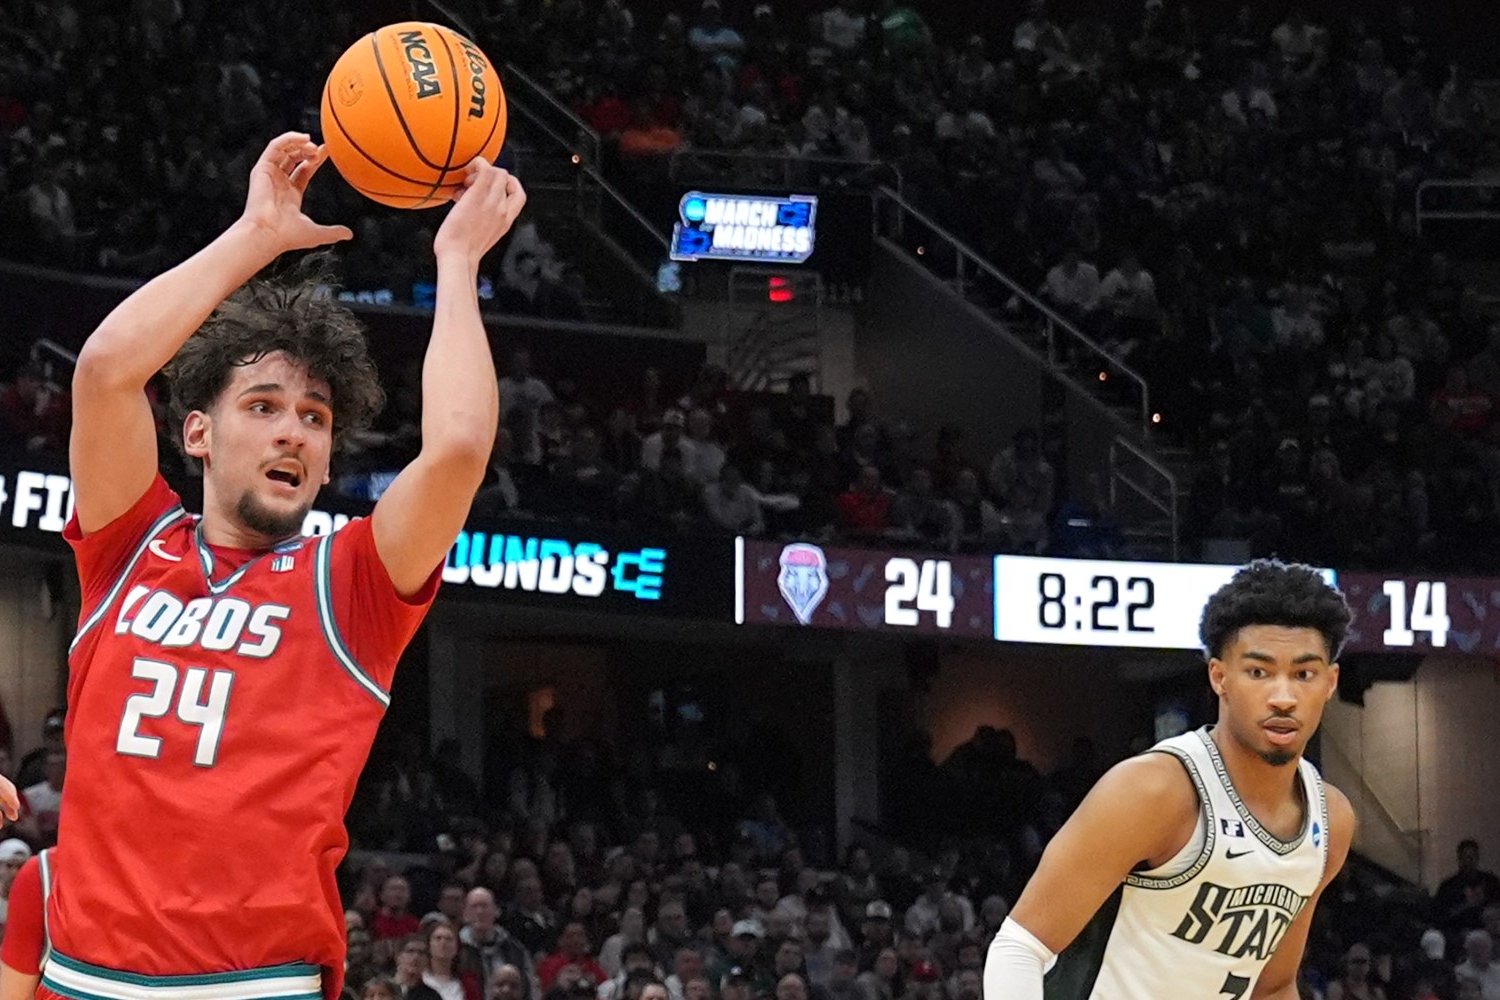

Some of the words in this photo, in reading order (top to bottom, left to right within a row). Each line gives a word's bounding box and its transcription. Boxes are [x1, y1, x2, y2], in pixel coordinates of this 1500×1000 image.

[397, 30, 442, 99] NCAA
[705, 198, 779, 227] MARCH
[713, 225, 810, 253] MADNESS
[441, 531, 609, 598] OUNDS
[885, 557, 955, 628] 24
[114, 584, 292, 660] LOBOS
[1038, 572, 1155, 633] 8:22
[1383, 580, 1451, 647] 14
[116, 656, 237, 768] 24
